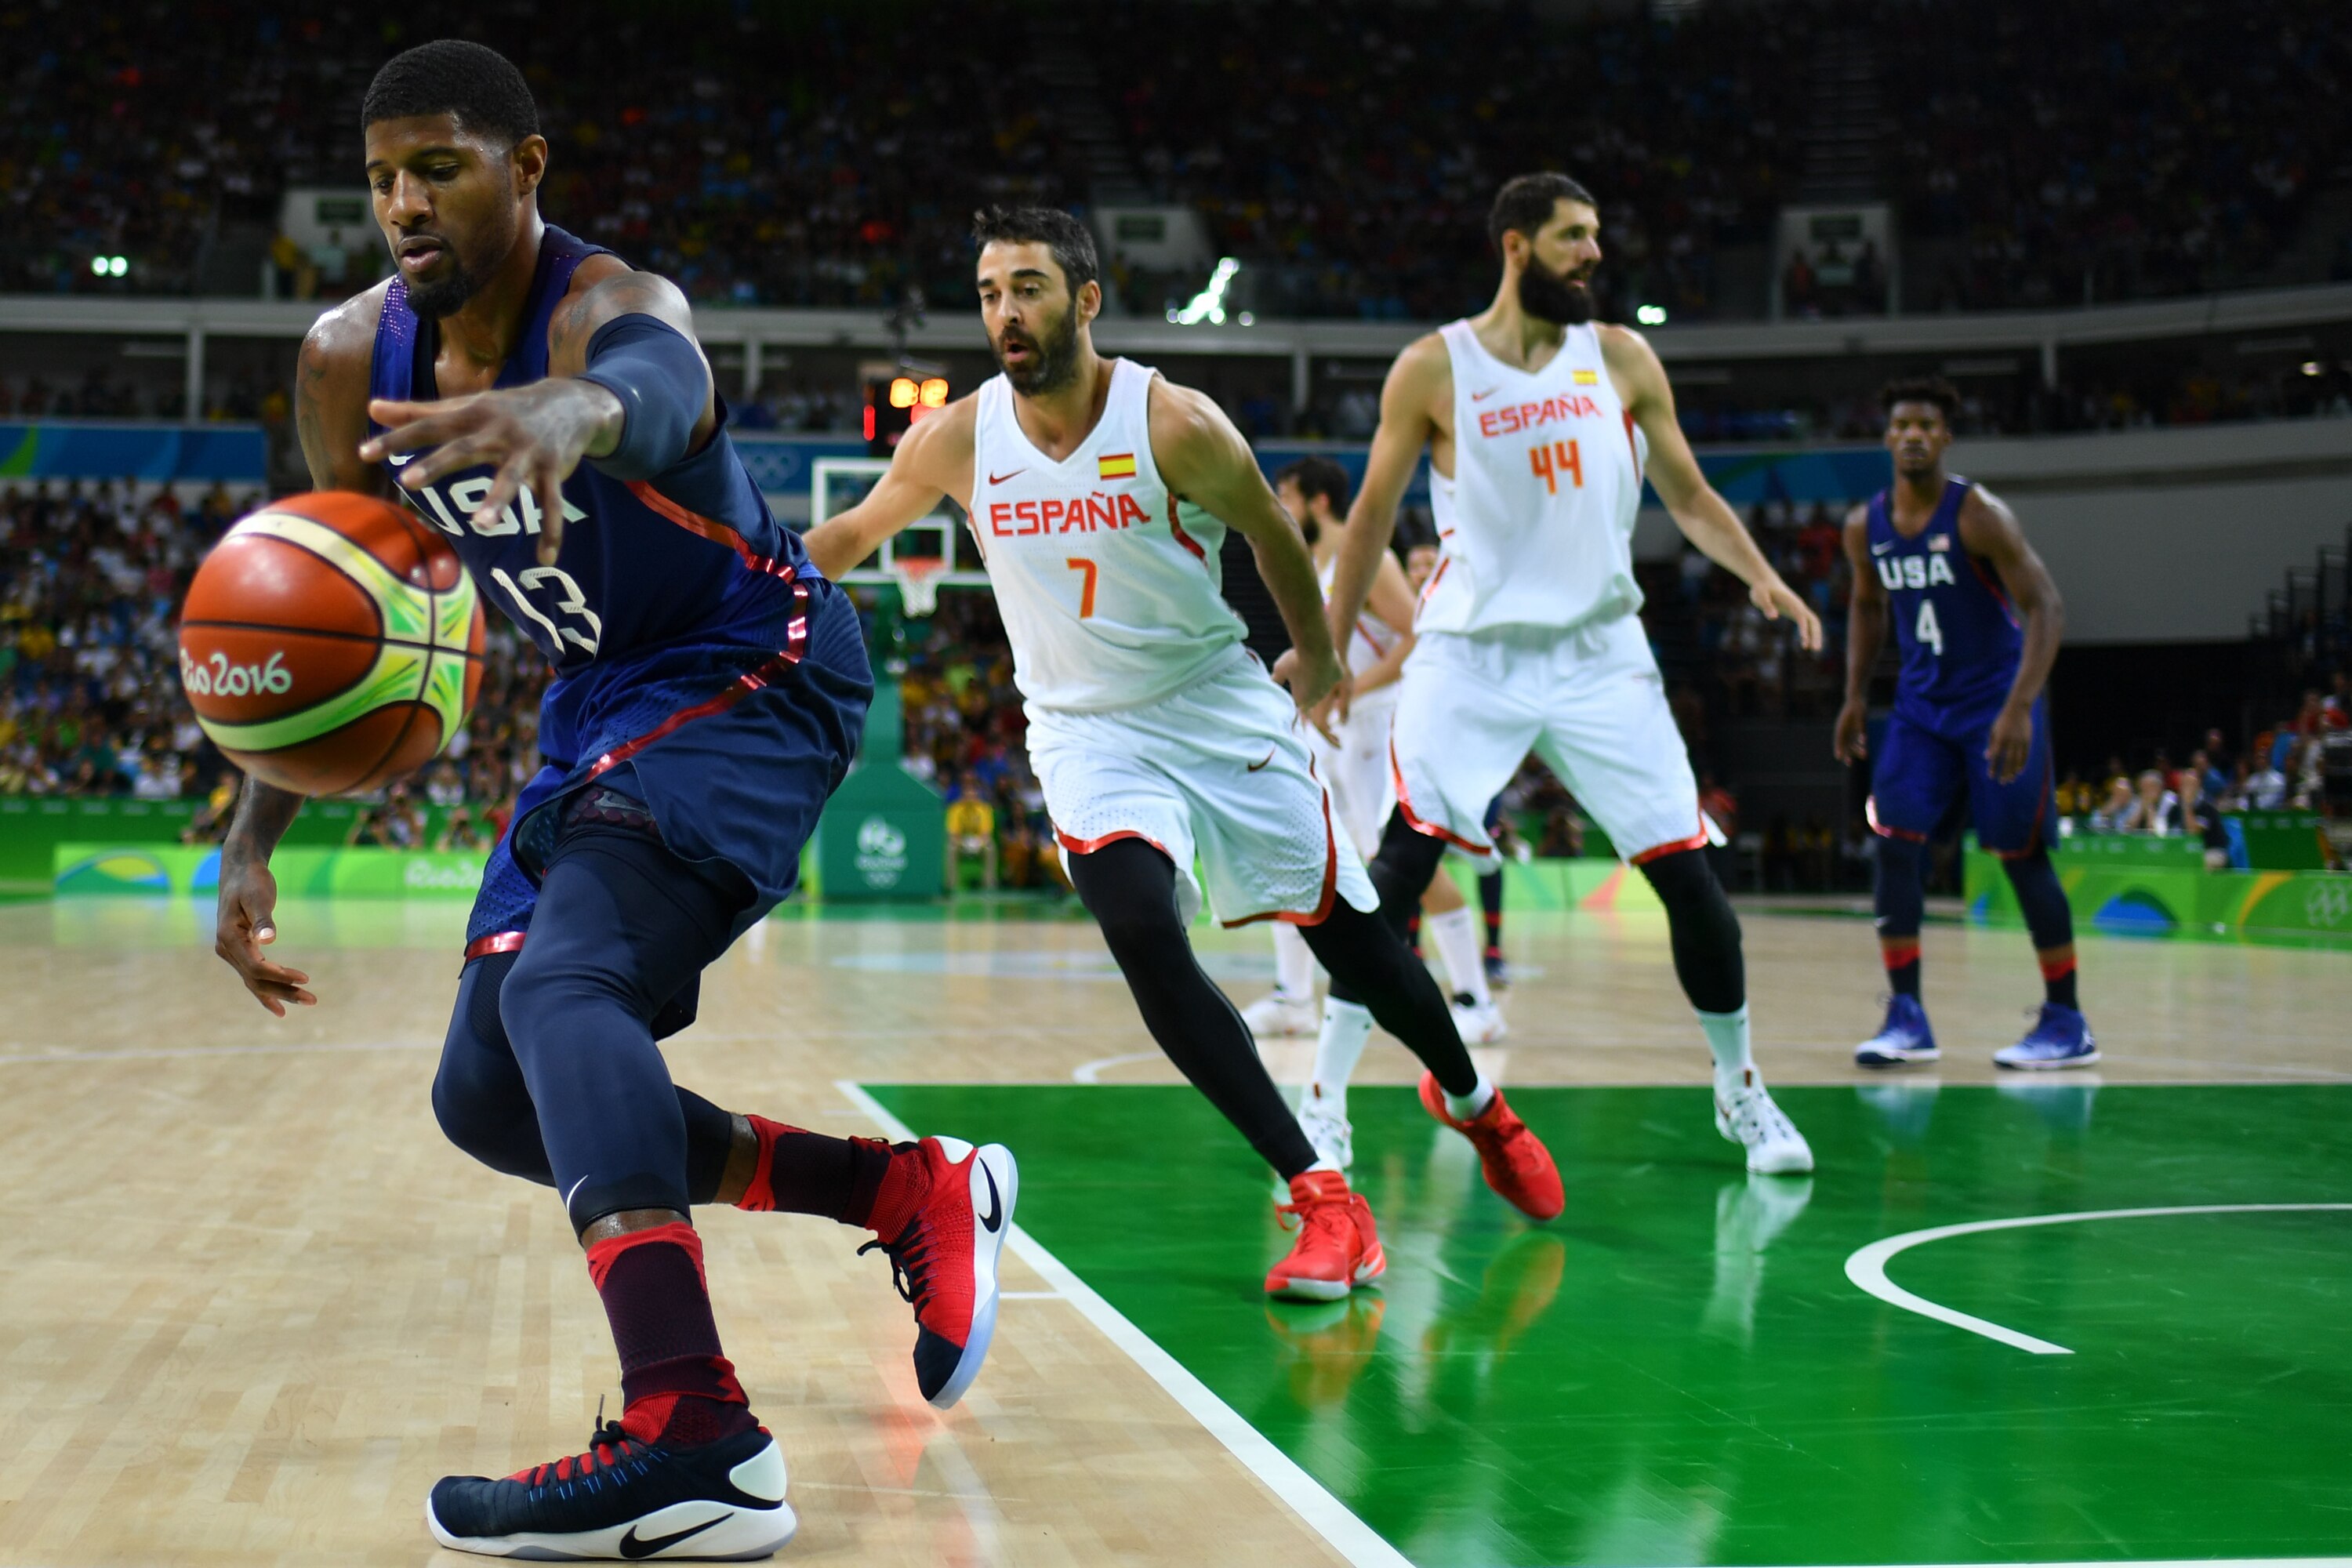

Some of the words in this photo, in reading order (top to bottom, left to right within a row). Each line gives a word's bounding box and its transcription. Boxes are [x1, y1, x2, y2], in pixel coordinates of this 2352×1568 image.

[1479, 391, 1604, 438] ESPAÑA
[1528, 438, 1583, 495] 44
[989, 492, 1151, 537] ESPAÑA
[1065, 557, 1098, 619] 7
[1877, 552, 1955, 590] USA
[490, 566, 601, 659] 13
[1915, 597, 1944, 655] 4
